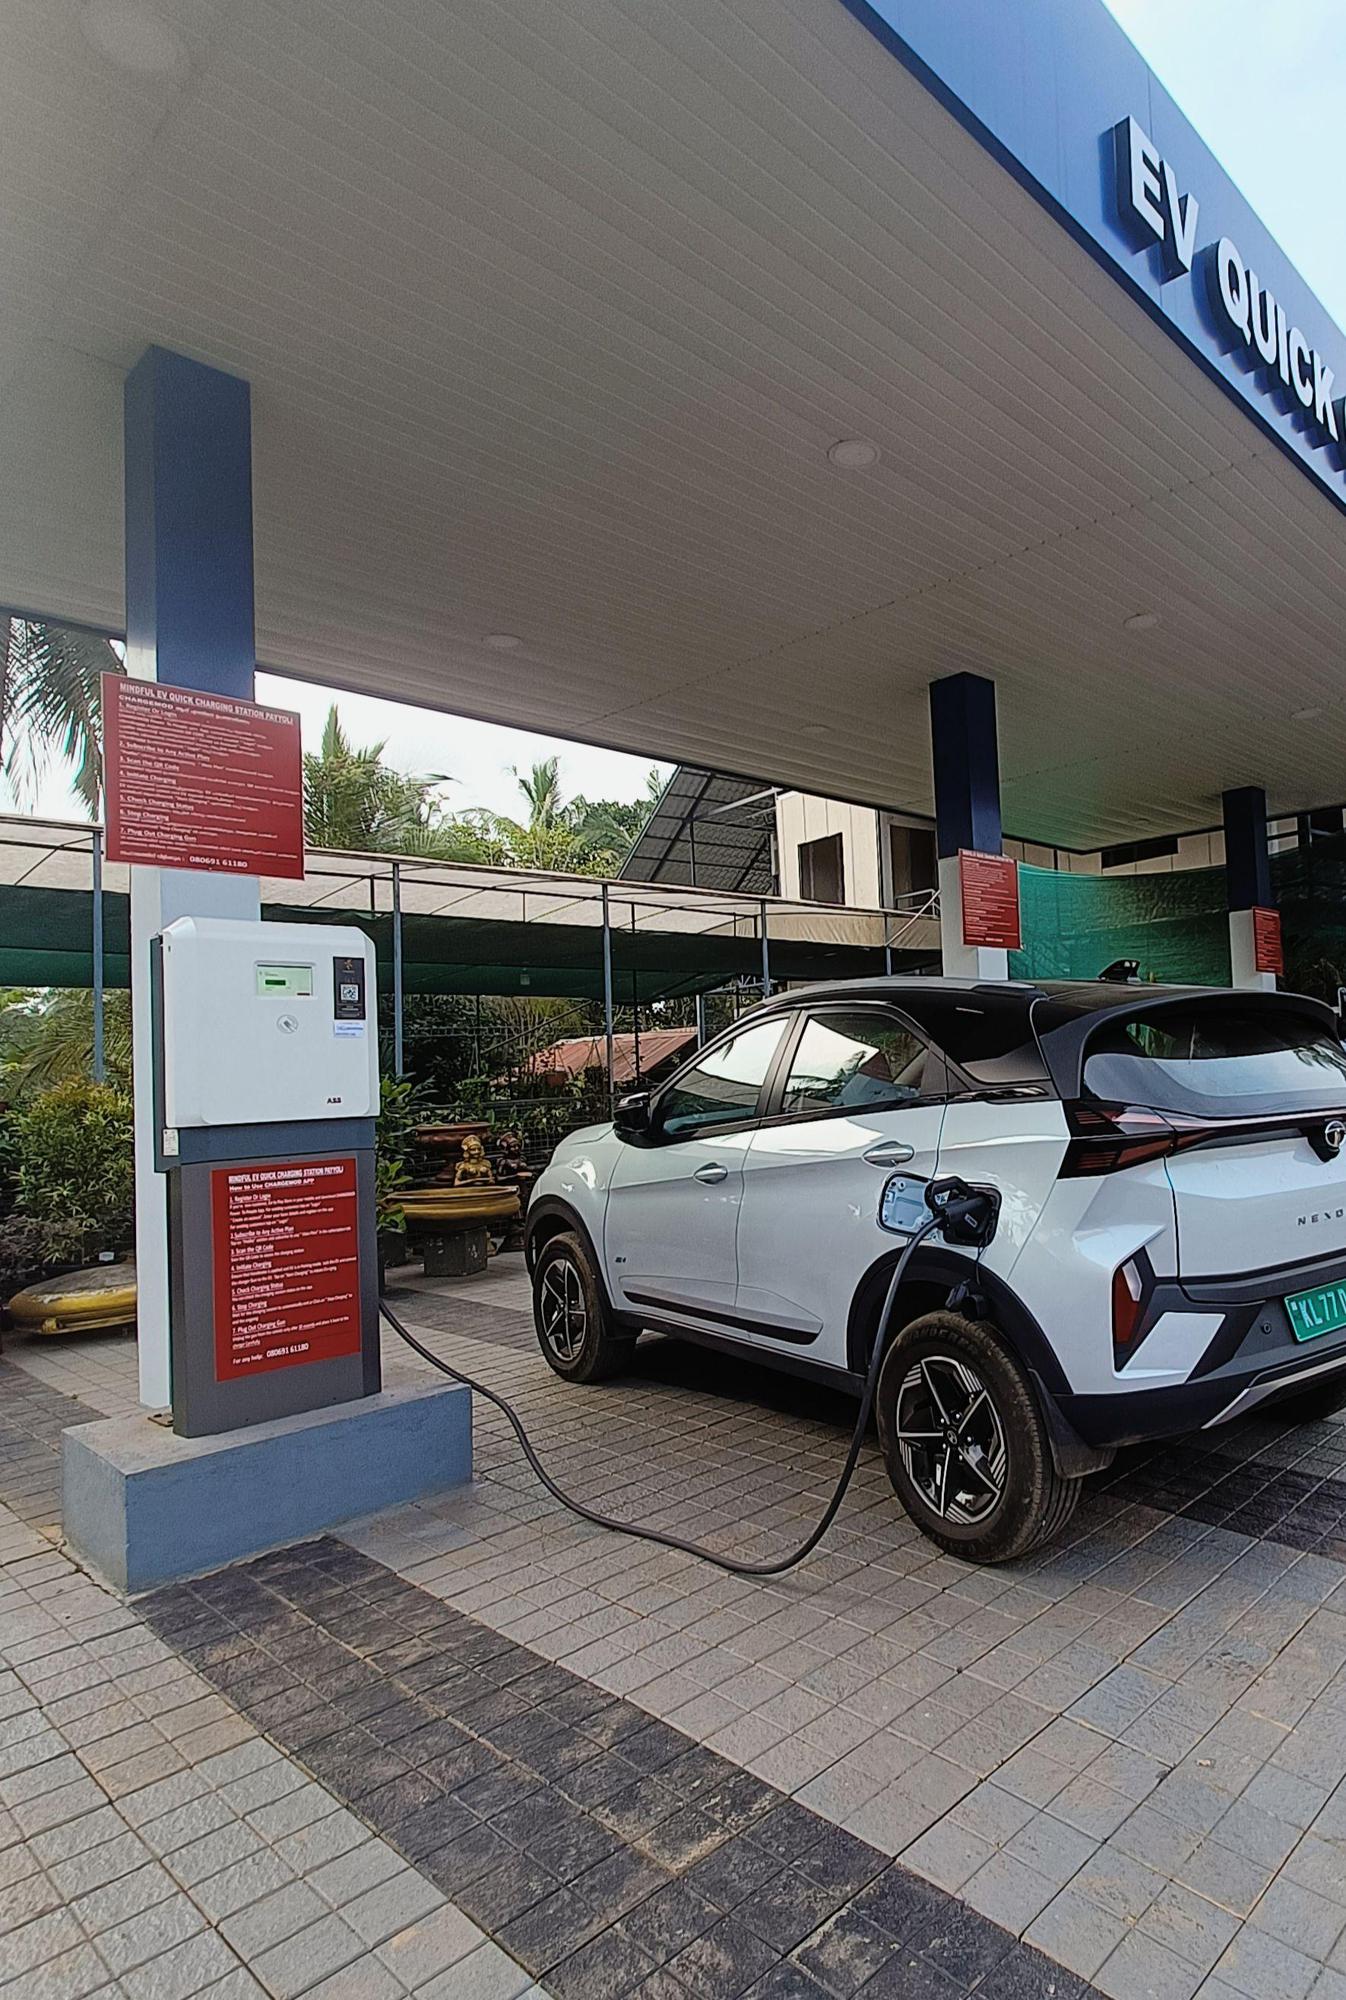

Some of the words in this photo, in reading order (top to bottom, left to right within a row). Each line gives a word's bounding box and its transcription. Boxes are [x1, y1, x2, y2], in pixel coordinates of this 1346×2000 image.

[1126, 115, 1199, 272] EV
[1216, 235, 1339, 442] QUICK
[119, 694, 173, 710] CHARGEMOD
[120, 682, 155, 697] MINDFUL
[157, 691, 167, 699] EV
[169, 693, 193, 704] QUICK
[195, 698, 233, 712] CHARGING
[235, 707, 264, 719] STATION
[189, 856, 220, 866] 080691
[222, 859, 248, 868] 61180
[290, 1342, 309, 1354] 61180
